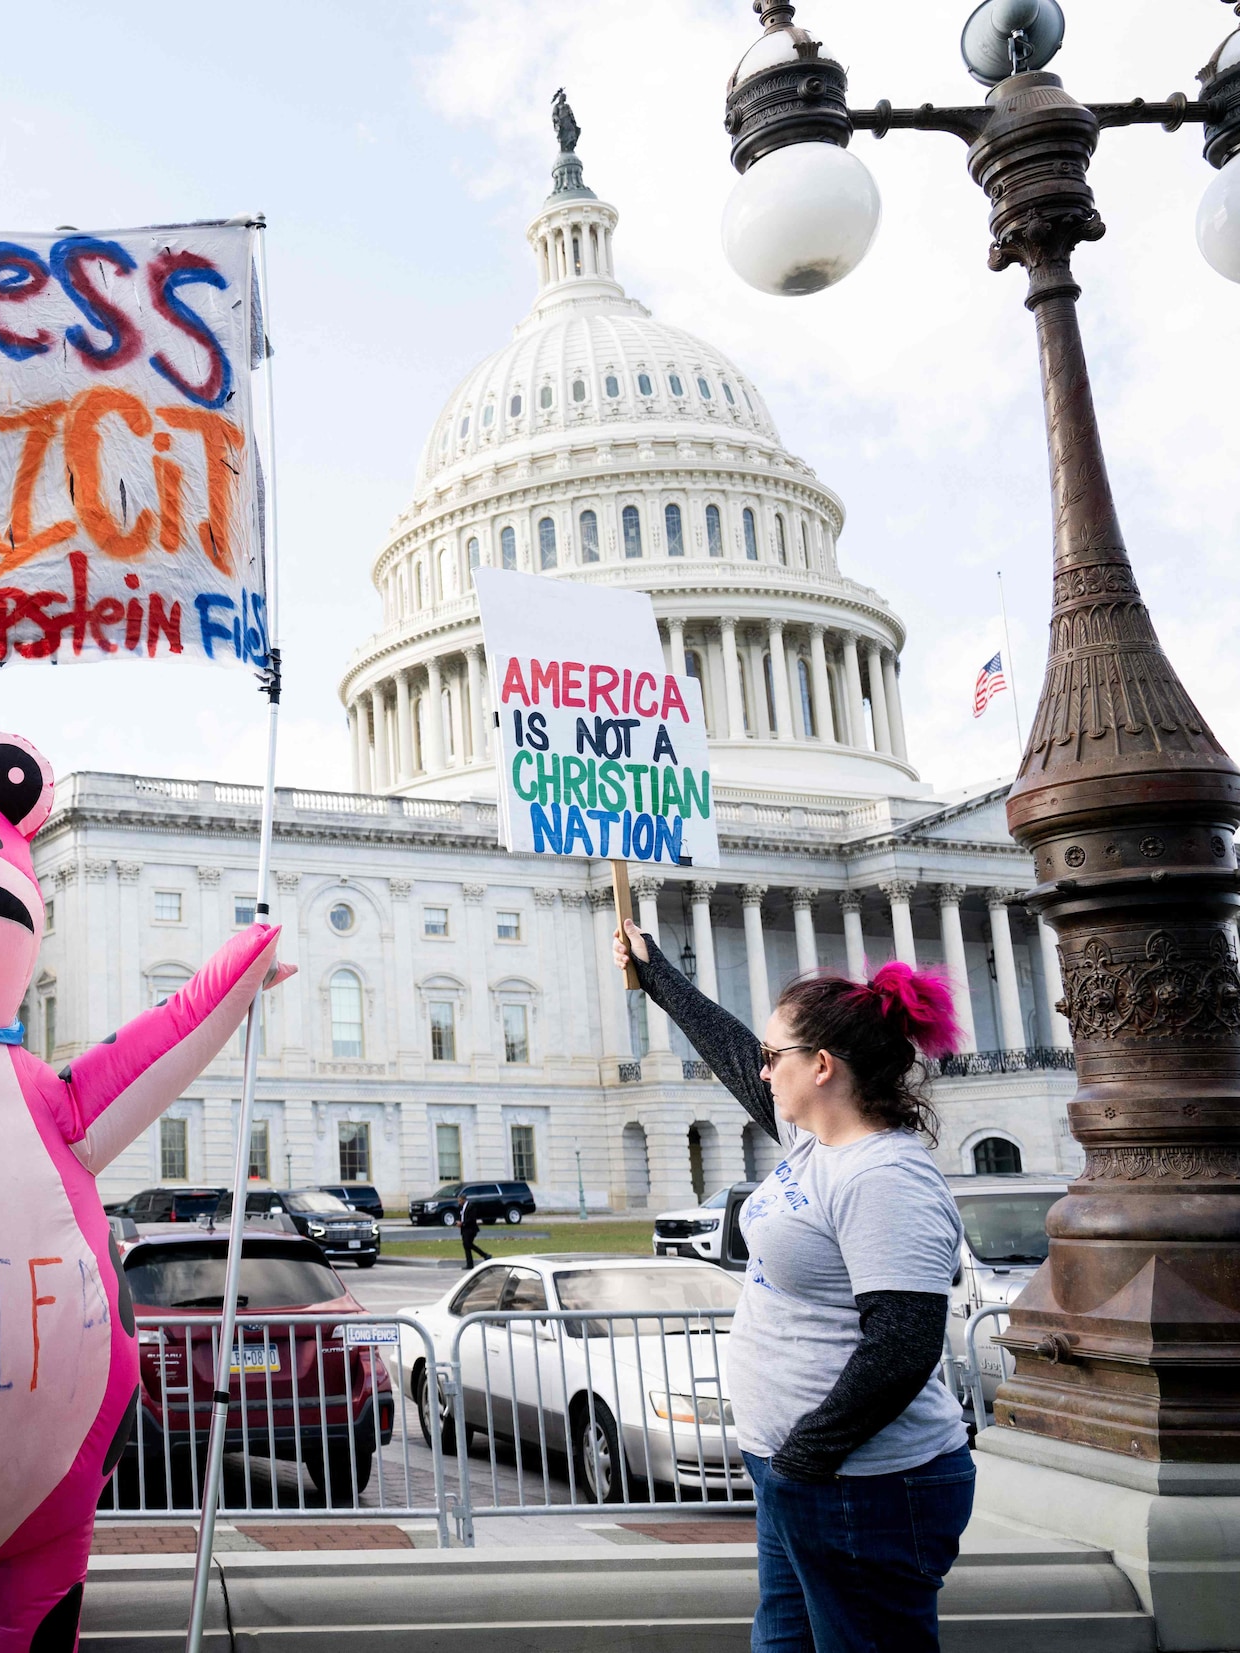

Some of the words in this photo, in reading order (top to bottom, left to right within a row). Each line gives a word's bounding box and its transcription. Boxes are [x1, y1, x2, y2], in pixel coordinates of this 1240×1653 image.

[501, 656, 690, 723] AMERICA
[513, 709, 550, 751] IS
[576, 715, 641, 760] NOT
[653, 723, 679, 765] A
[512, 749, 710, 820] CHRISTIAN
[530, 802, 684, 864] NATION
[349, 1328, 371, 1340] LONG
[372, 1328, 396, 1340] FENCE
